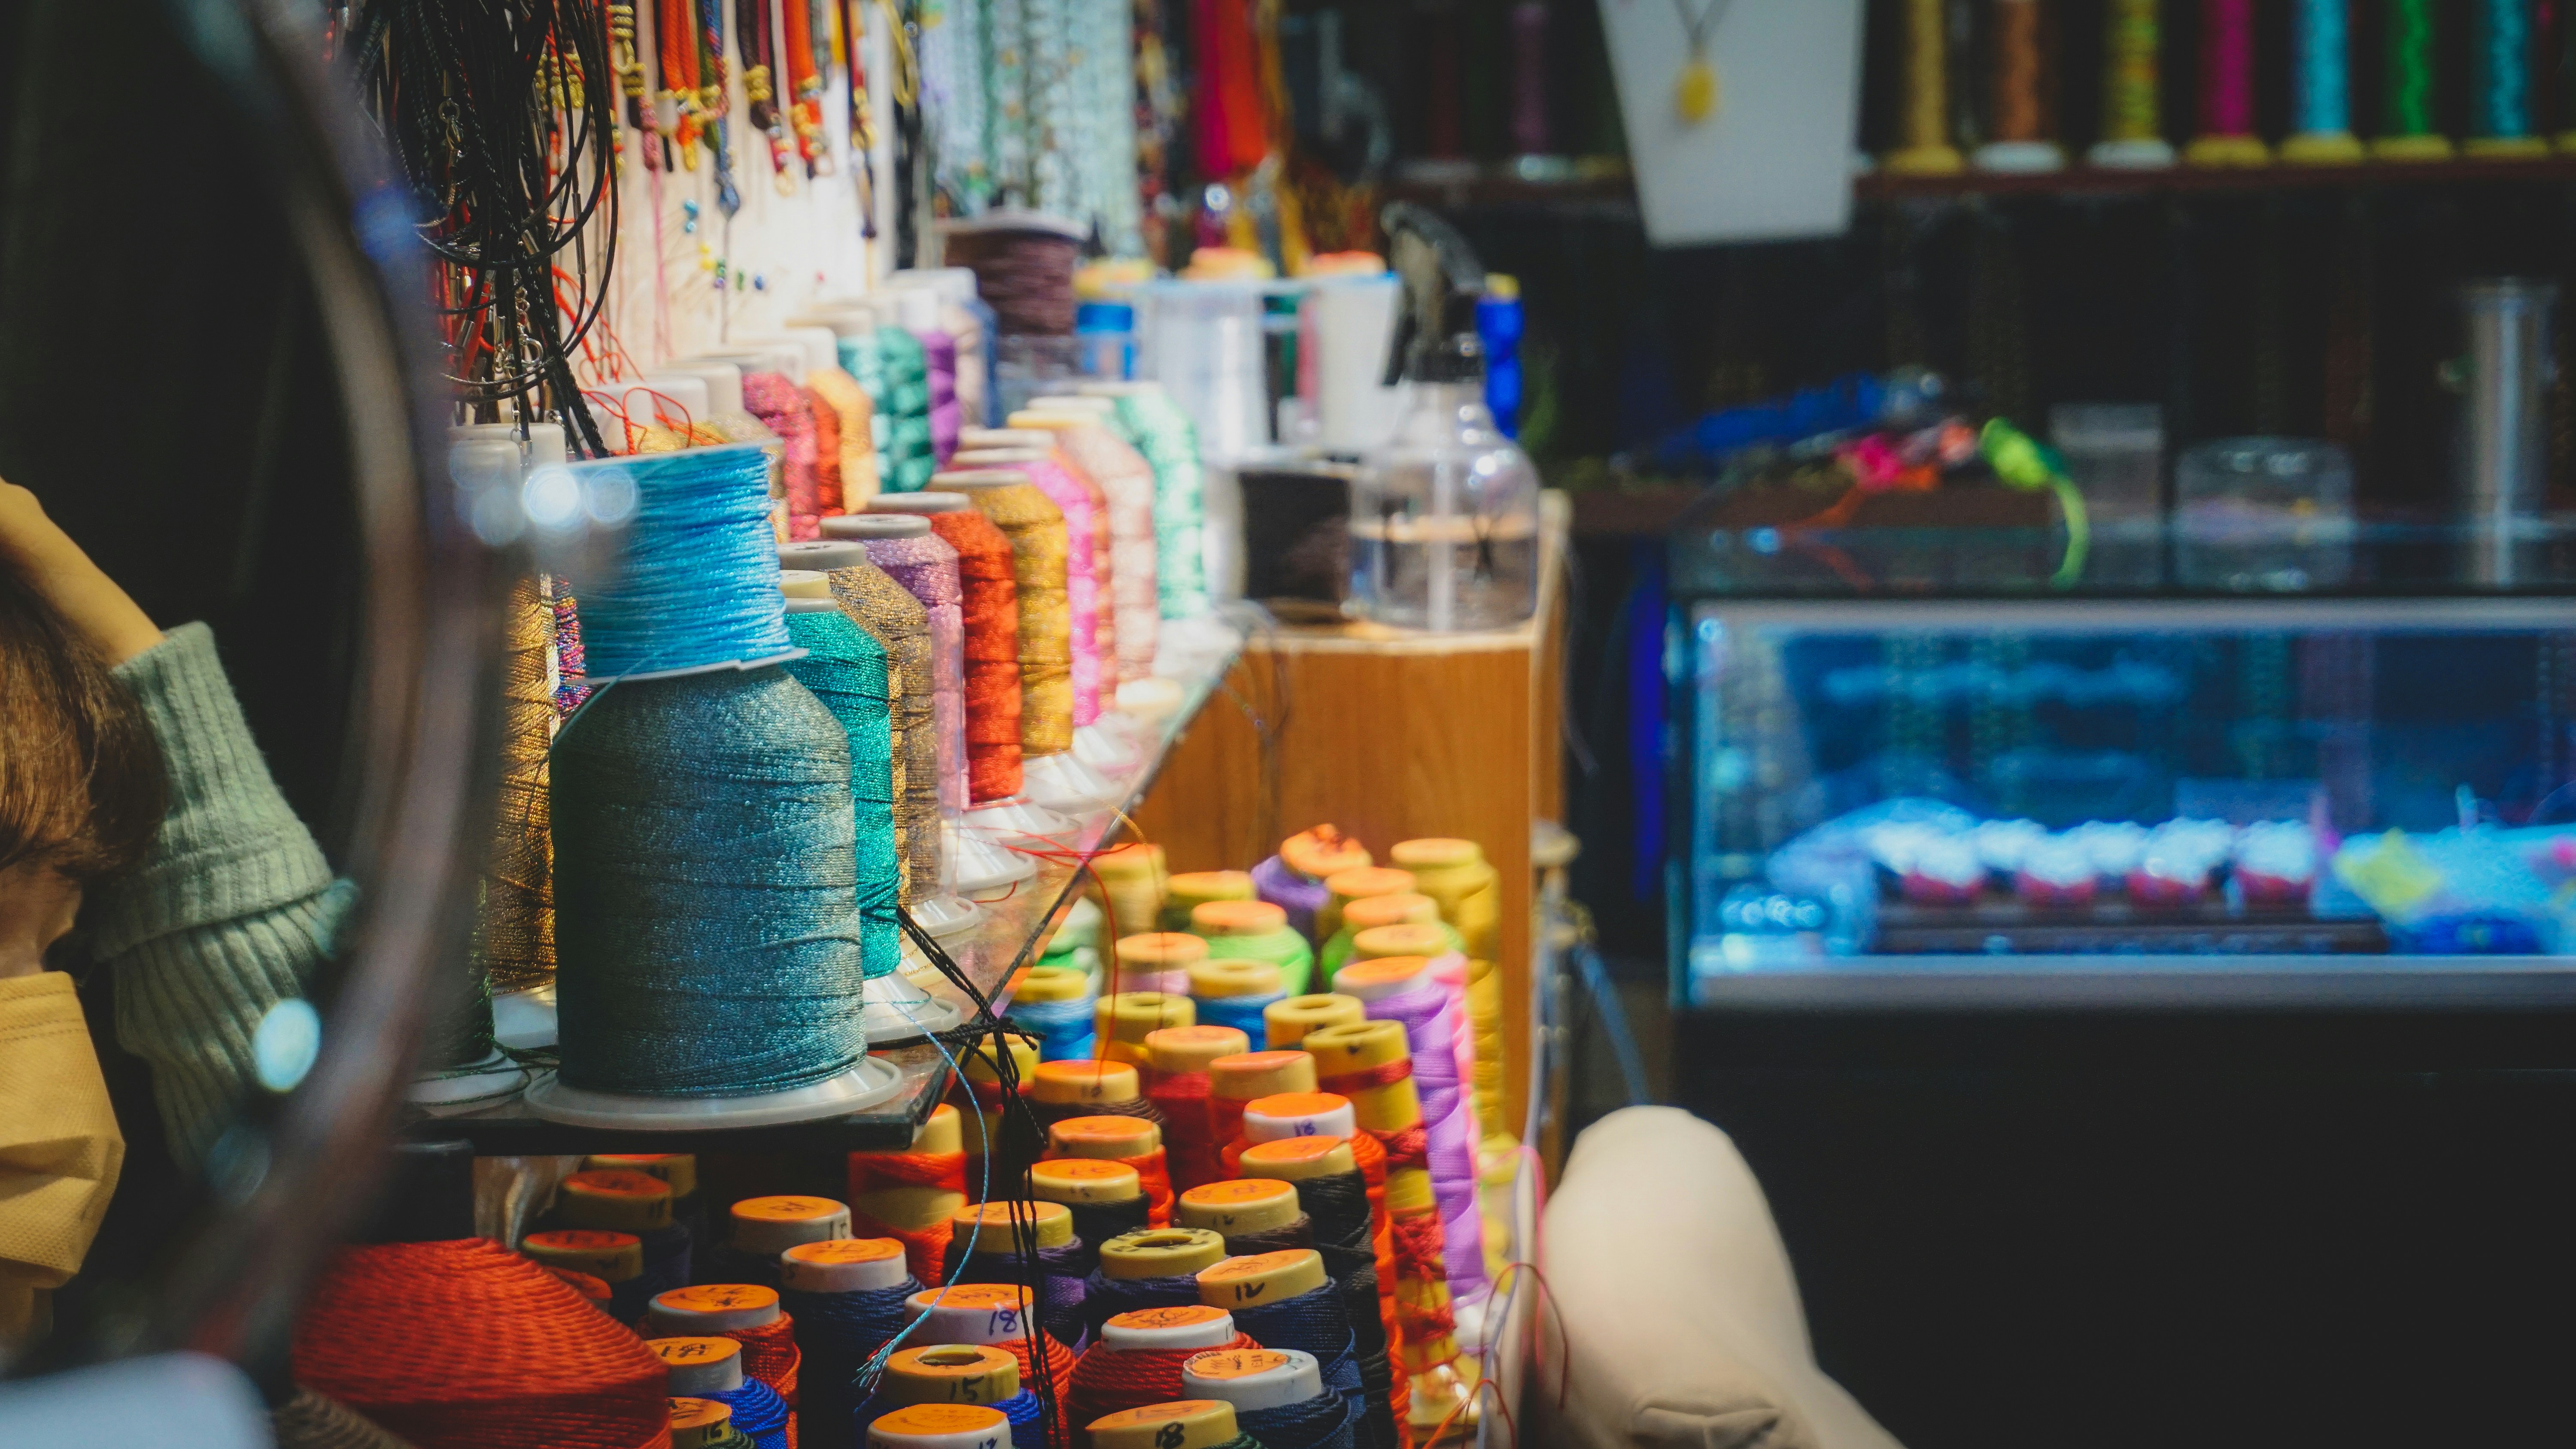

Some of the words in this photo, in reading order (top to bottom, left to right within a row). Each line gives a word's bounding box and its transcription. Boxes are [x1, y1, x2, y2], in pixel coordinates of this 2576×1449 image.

[989, 1310, 1018, 1337] 18
[949, 1375, 984, 1402] 15
[702, 1419, 726, 1441] 16
[1155, 1421, 1185, 1449] 18
